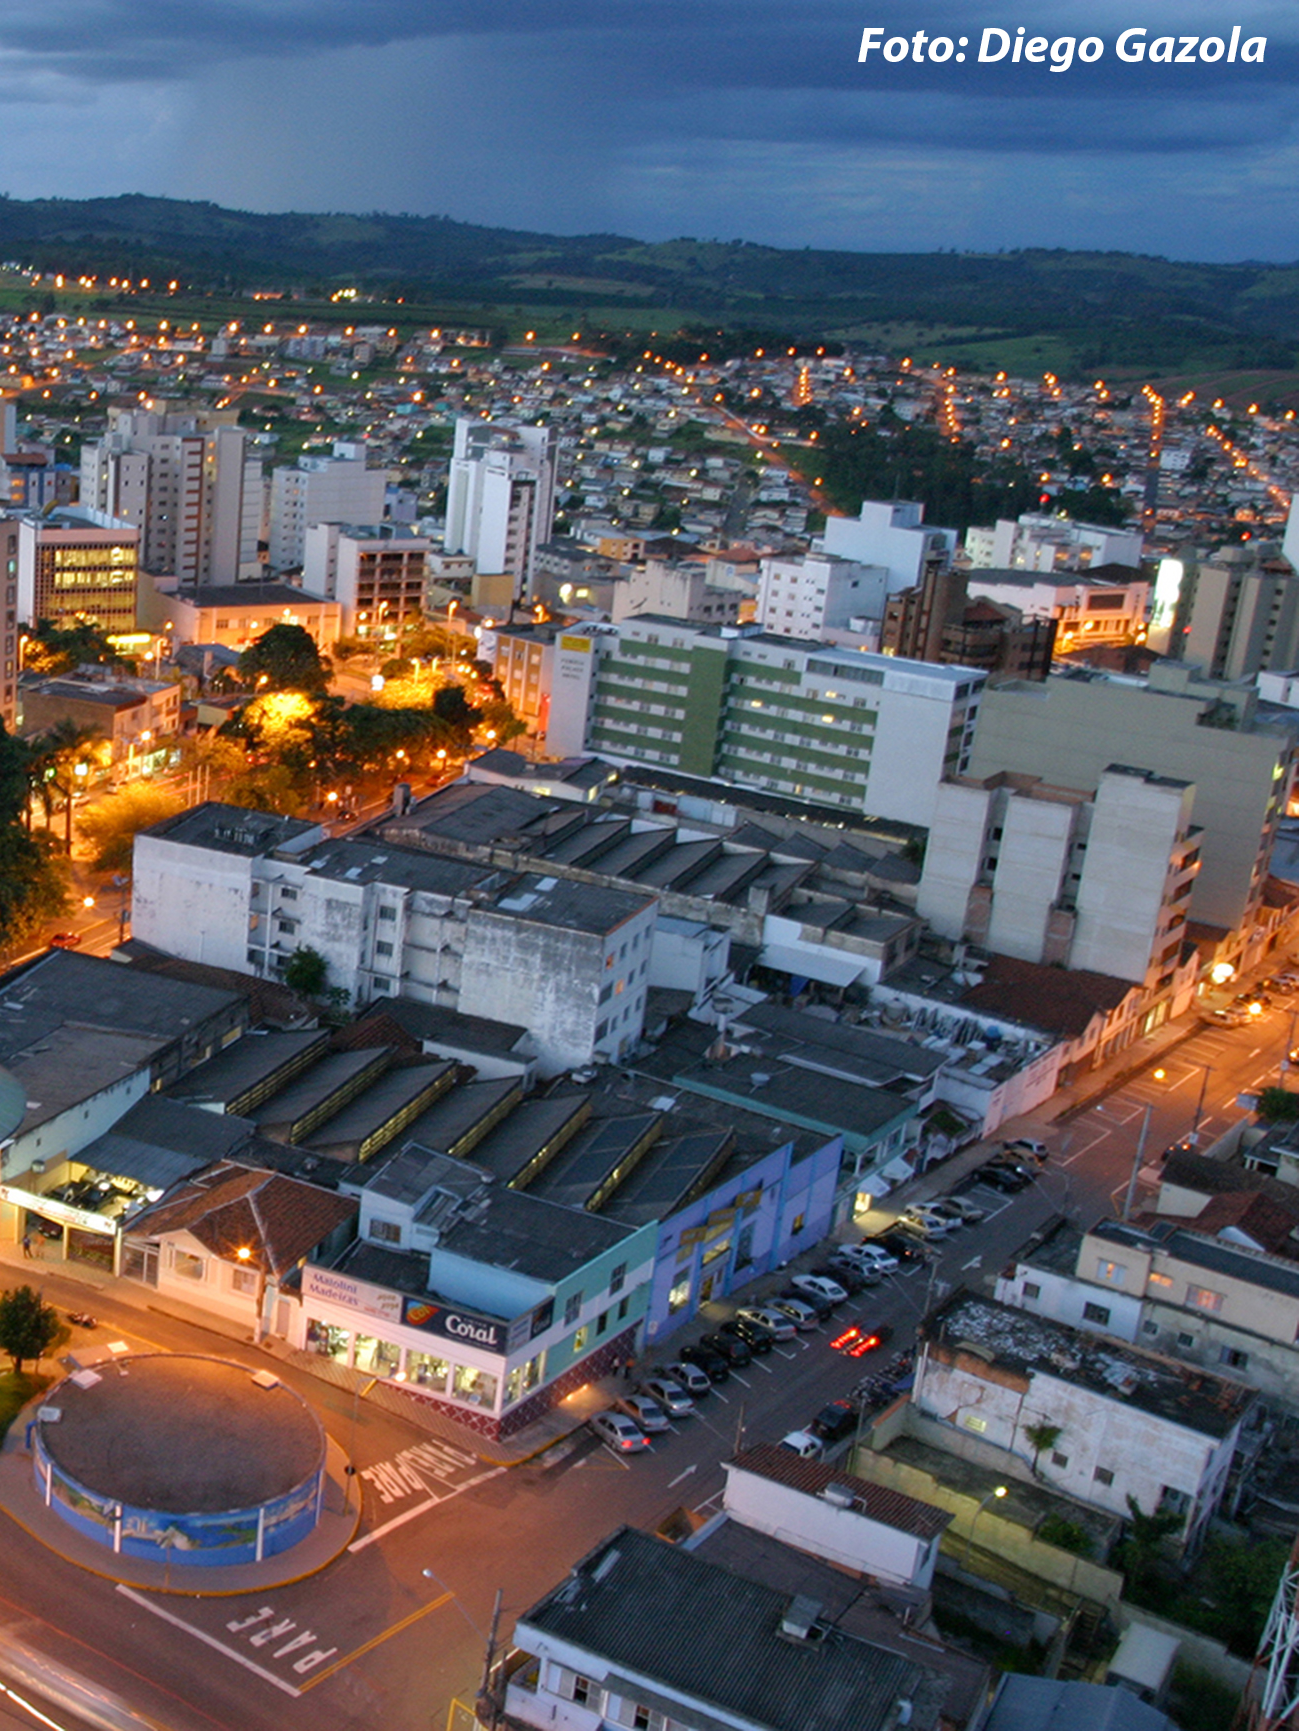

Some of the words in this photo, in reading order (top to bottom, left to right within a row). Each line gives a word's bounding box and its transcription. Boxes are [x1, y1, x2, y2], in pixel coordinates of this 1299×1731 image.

[309, 1284, 358, 1306] Madeiras
[445, 1314, 498, 1345] Coral
[401, 1438, 477, 1478] PARE
[361, 1458, 423, 1504] PARE
[226, 1606, 338, 1674] PARE
